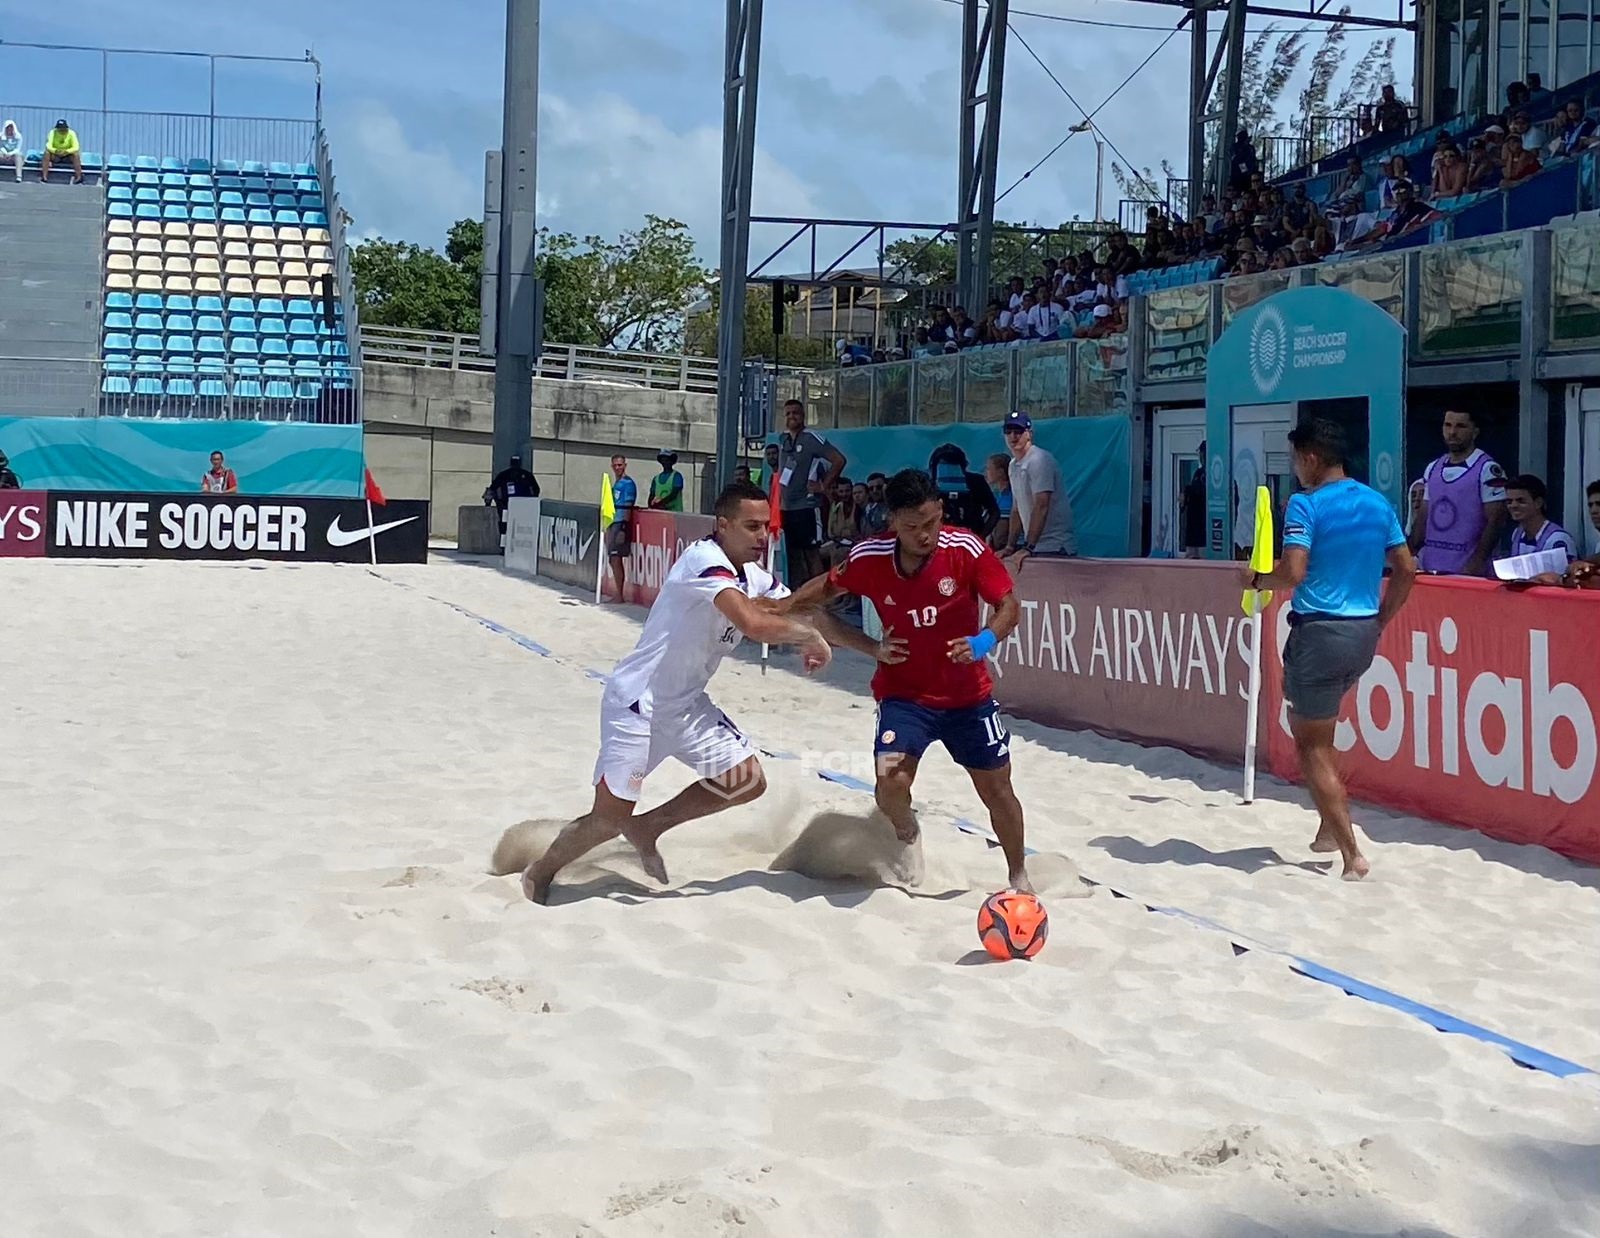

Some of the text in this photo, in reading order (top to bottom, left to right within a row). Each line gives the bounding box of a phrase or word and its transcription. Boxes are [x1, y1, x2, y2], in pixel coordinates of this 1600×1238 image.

[1317, 331, 1347, 348] SOCCER
[55, 500, 307, 552] NIKE SOCCER
[907, 605, 938, 628] 10
[1089, 605, 1260, 702] AIRWAYS
[1276, 600, 1598, 805] otiab
[980, 710, 1007, 746] 10
